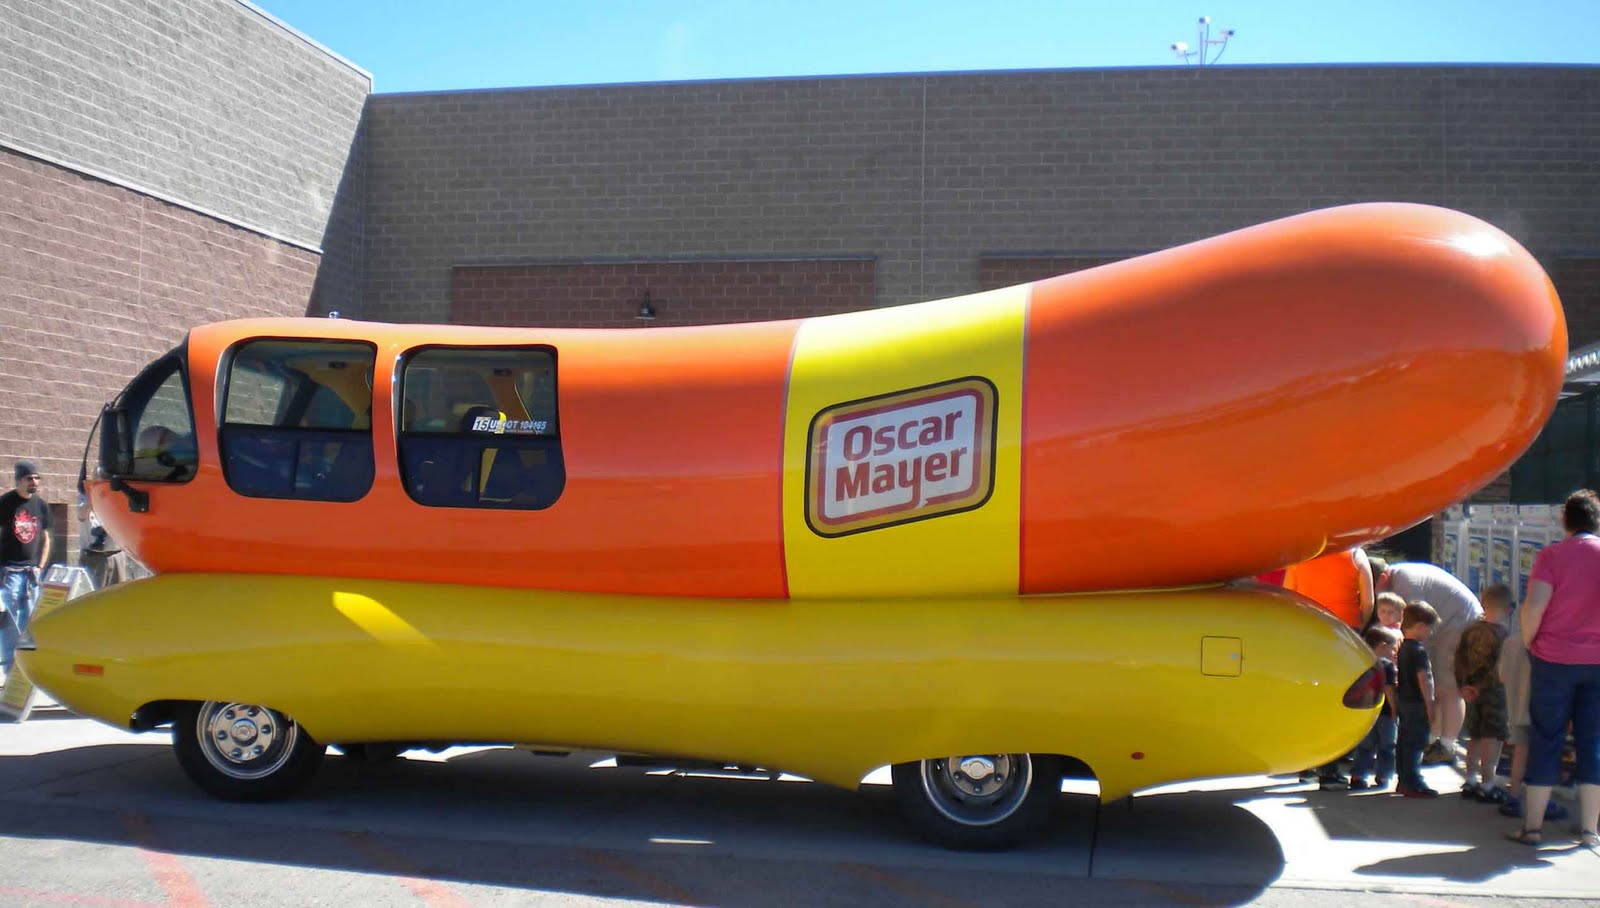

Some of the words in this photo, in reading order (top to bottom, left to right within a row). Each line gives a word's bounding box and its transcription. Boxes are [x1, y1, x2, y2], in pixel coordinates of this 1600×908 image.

[475, 419, 489, 431] 15
[843, 408, 962, 462] Oscar
[835, 446, 967, 507] Mayer
